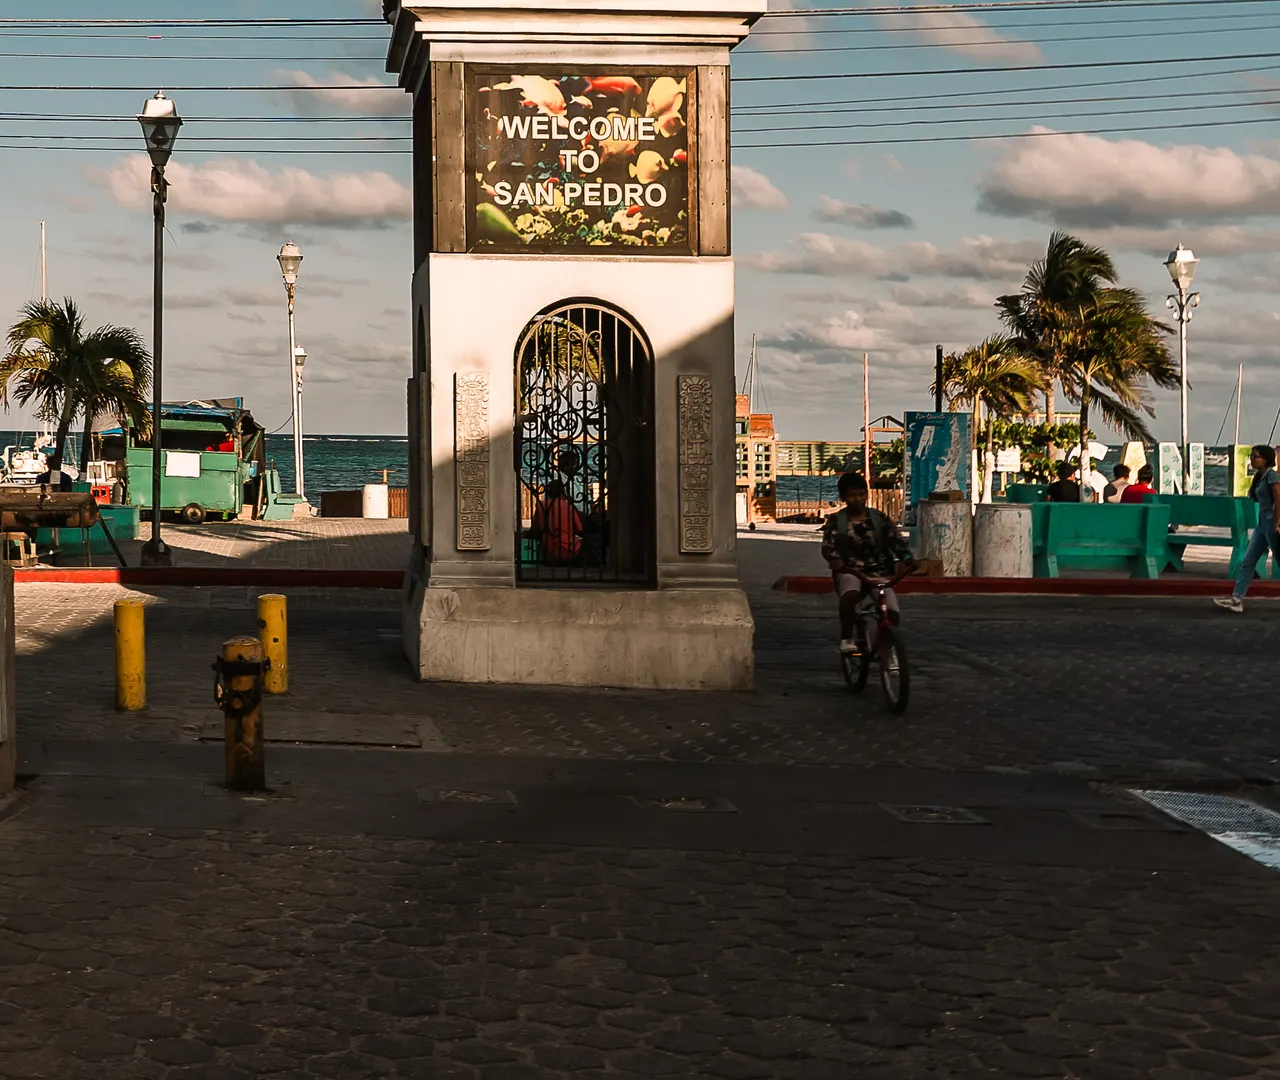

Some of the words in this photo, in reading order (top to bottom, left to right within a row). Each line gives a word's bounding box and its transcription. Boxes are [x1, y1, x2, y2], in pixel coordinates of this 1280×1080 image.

[502, 116, 655, 141] WELCOME
[559, 149, 599, 173] TO
[493, 181, 554, 206] SAN
[564, 182, 667, 207] PEDRO
